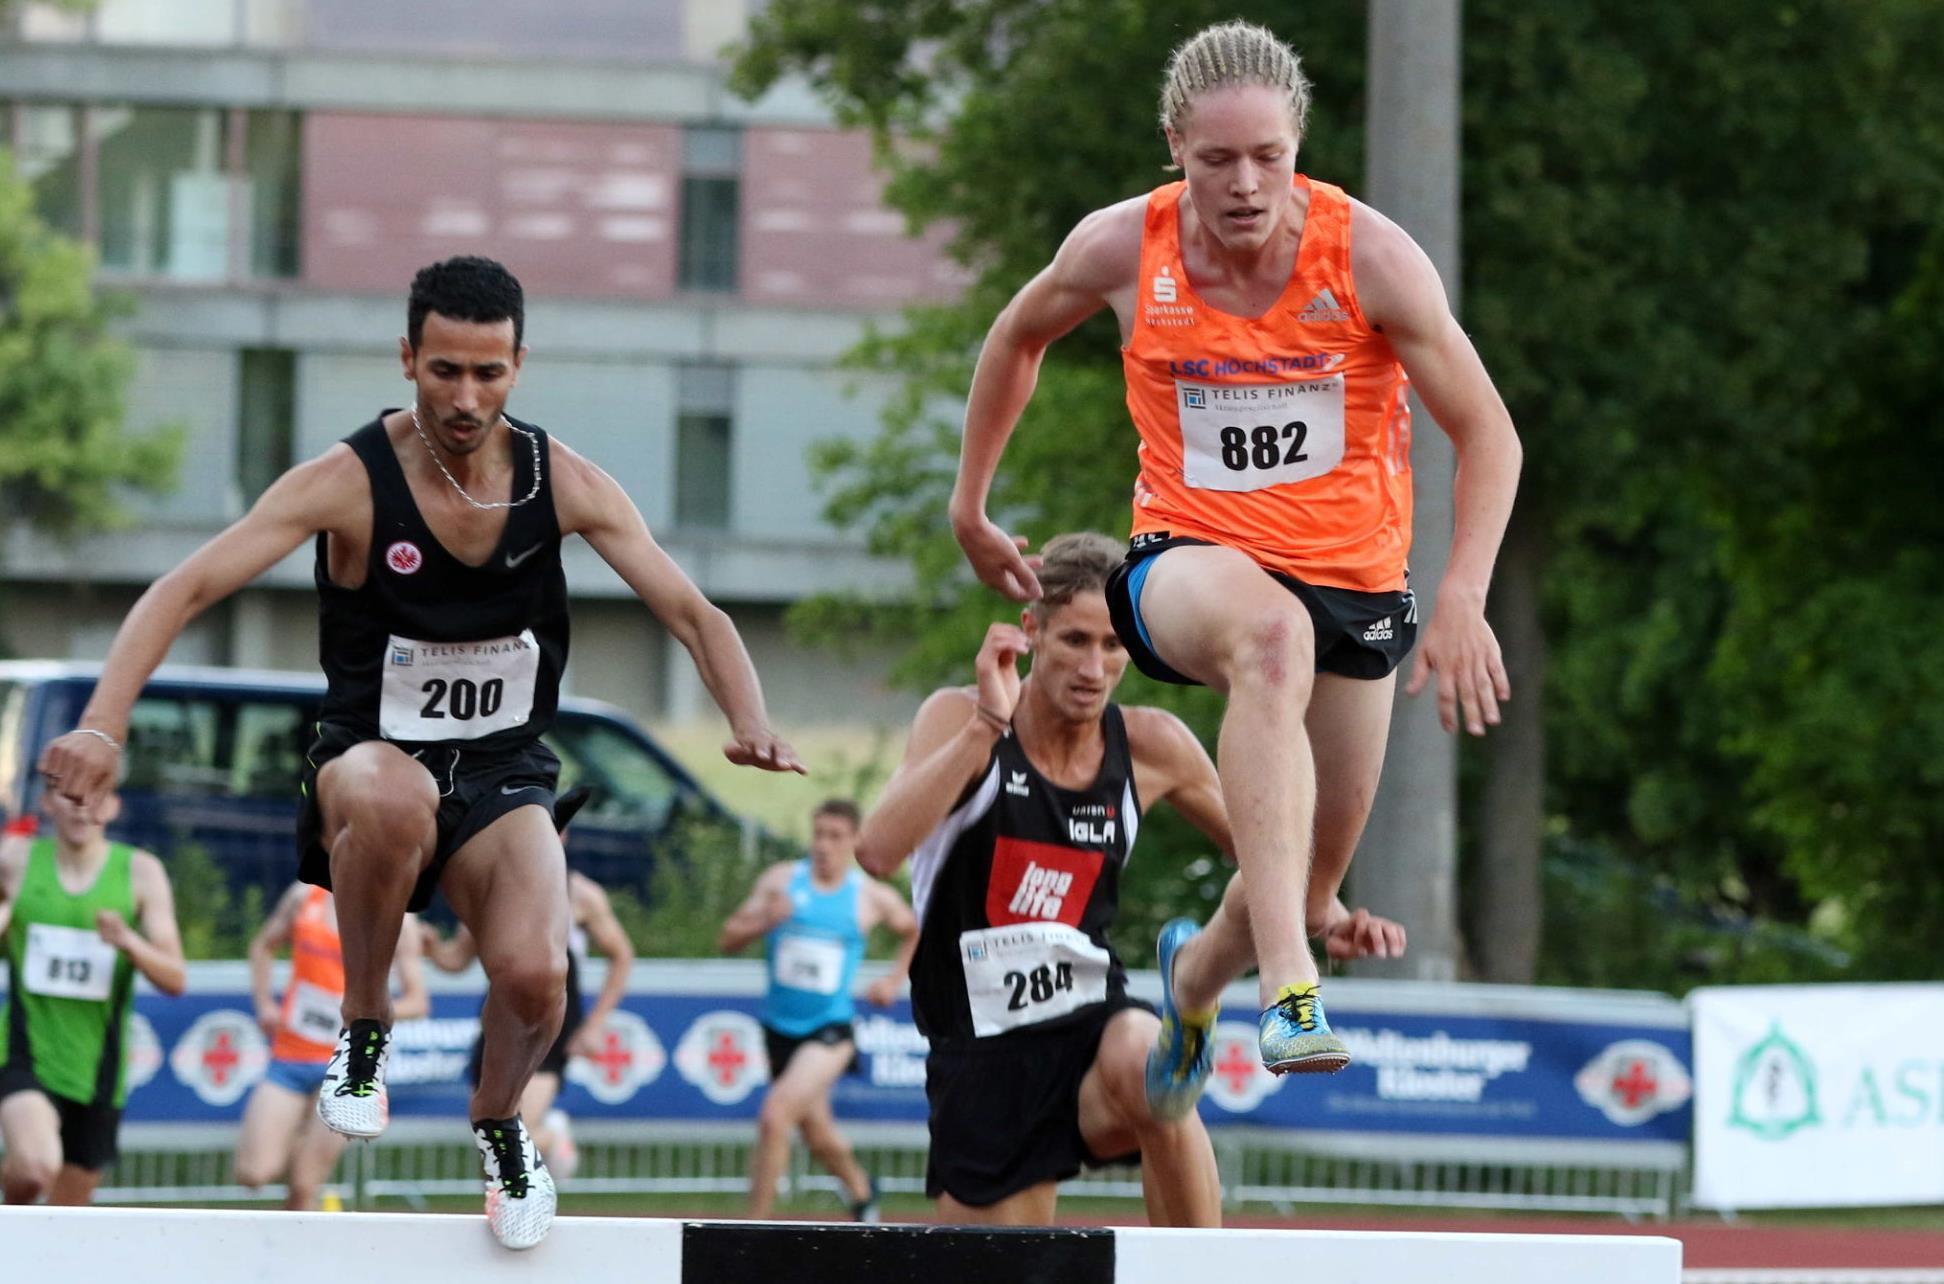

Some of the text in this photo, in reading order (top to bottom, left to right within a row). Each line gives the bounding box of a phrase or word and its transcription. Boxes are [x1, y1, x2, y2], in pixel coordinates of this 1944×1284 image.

[1169, 360, 1210, 377] LSC
[1212, 388, 1259, 400] TELIS
[1219, 421, 1308, 471] 882
[1363, 629, 1394, 641] adidas
[422, 645, 465, 657] TELIS
[420, 678, 504, 721] 200
[1003, 961, 1073, 1012] 284
[1842, 1060, 1944, 1127] AS
